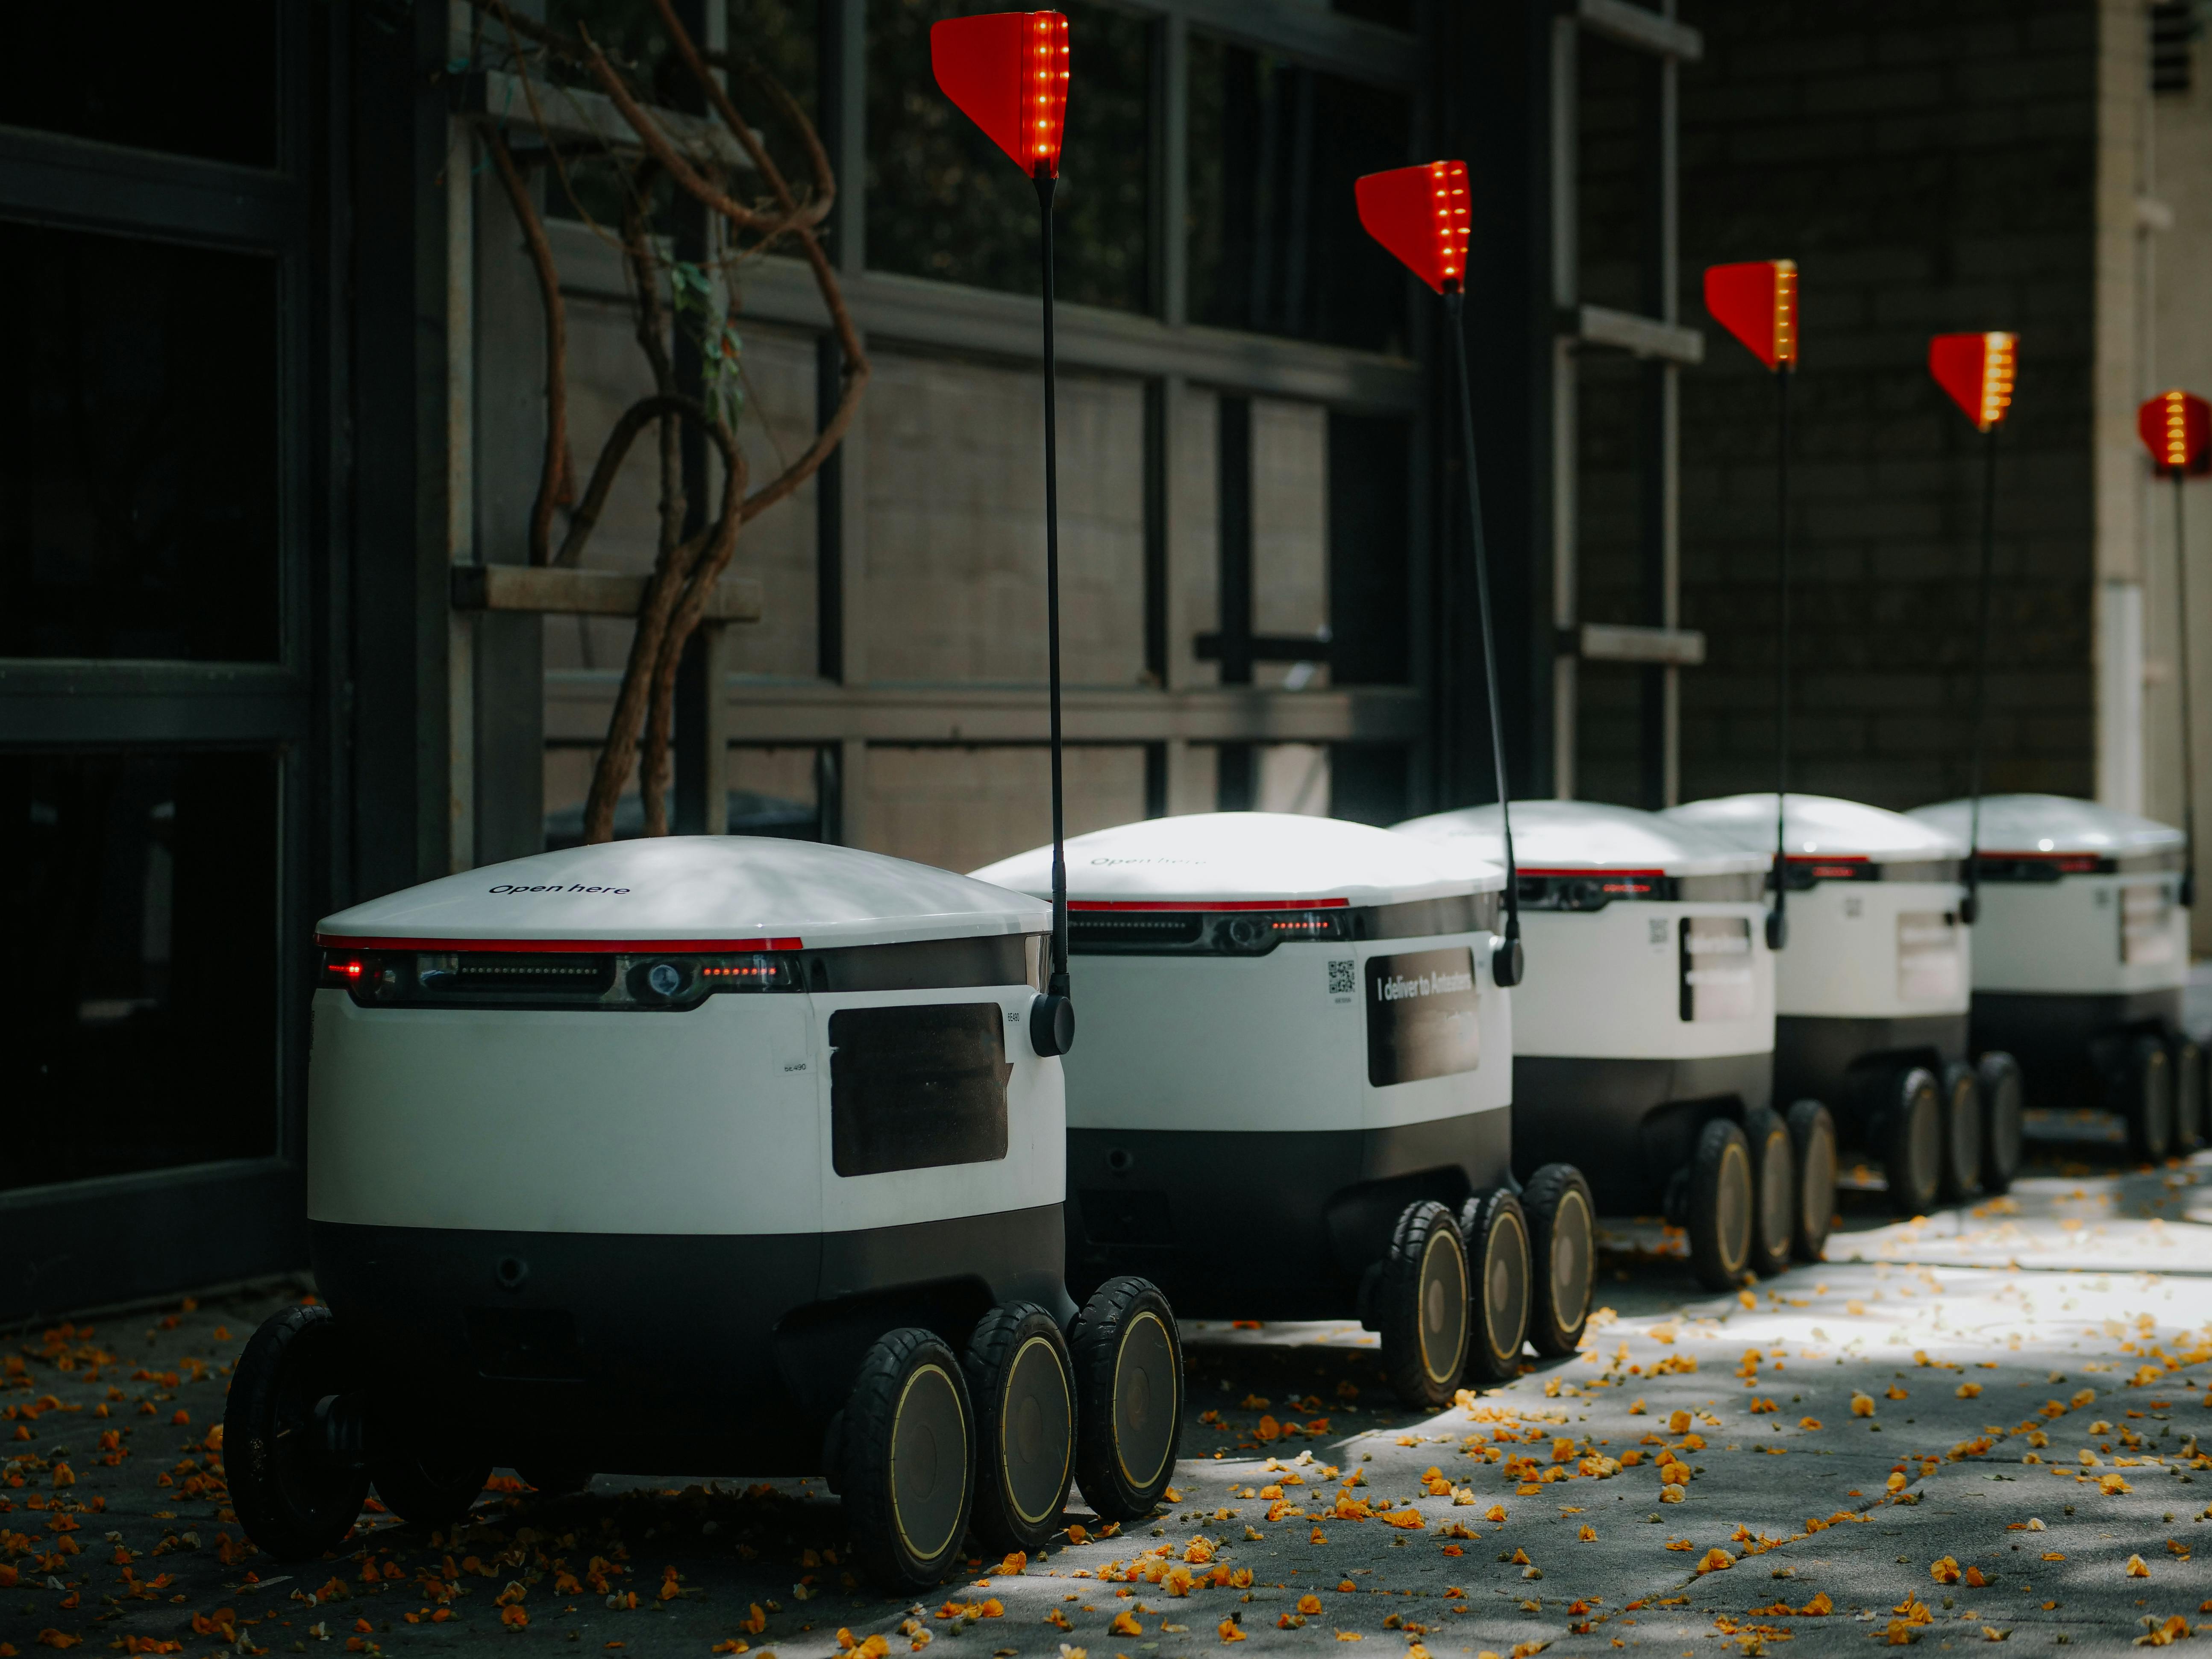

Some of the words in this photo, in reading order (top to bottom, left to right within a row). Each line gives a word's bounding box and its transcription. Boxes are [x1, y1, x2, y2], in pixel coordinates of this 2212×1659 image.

[1090, 858, 1151, 866] Open
[489, 885, 564, 895] Open
[567, 884, 630, 895] here
[1377, 977, 1383, 1001] I
[1384, 974, 1418, 1001] deliver
[1419, 975, 1430, 996] to
[1008, 1013, 1019, 1022] 6E490
